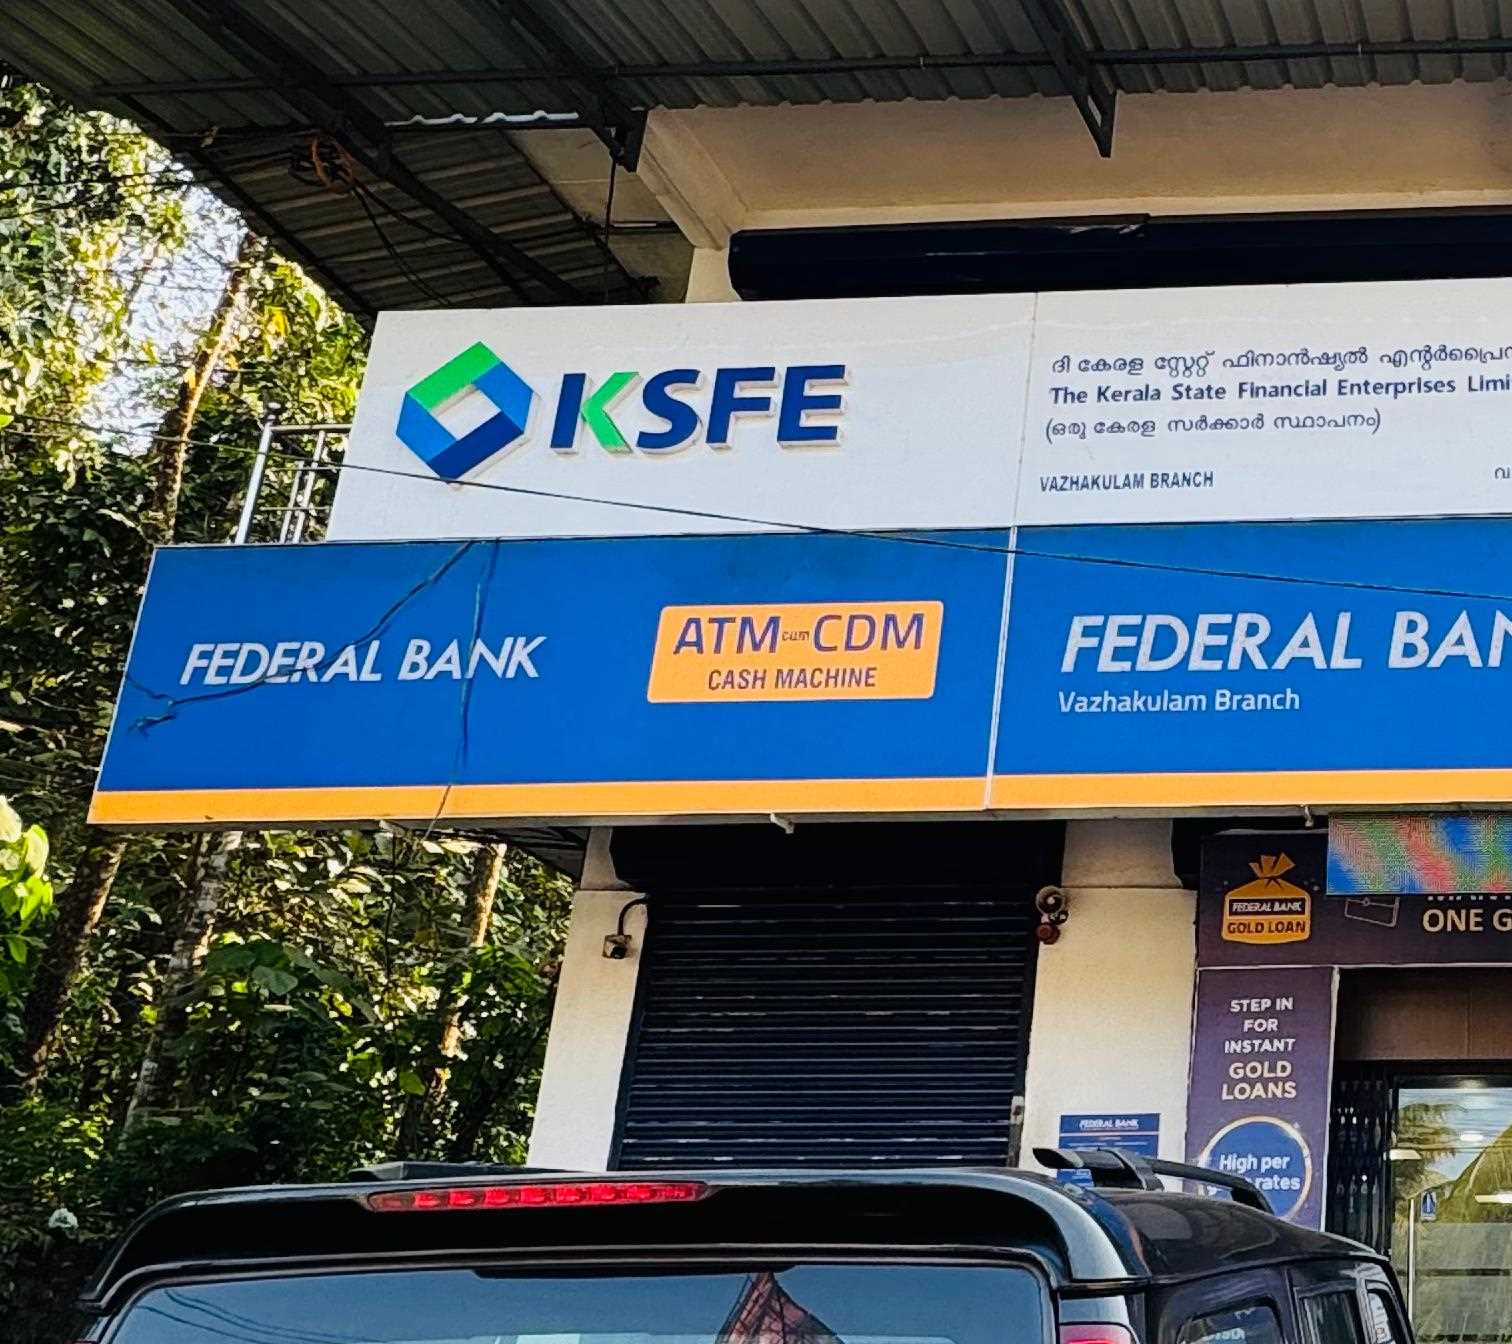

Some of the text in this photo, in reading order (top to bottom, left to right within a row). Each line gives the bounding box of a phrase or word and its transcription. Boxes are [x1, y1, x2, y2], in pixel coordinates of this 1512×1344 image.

[1052, 354, 1070, 373] ദി
[1078, 356, 1144, 375] കേരള
[1222, 346, 1368, 372] ഫിനാൻഷ്യൽ
[1050, 386, 1088, 404] The
[1097, 384, 1161, 403] Kerala
[1171, 382, 1227, 400] State
[1238, 379, 1327, 399] Financial
[1338, 376, 1456, 399] Enterprises
[549, 362, 848, 454] KSFE
[1046, 408, 1382, 444] (ഒരു കേരള സർക്കാർ സ്ഥാപനം)
[1040, 470, 1215, 492] VAZHAKULAM BRANCH
[673, 616, 781, 654] ATM
[814, 613, 924, 652] CDM
[1061, 612, 1363, 673] FEDERAL
[180, 636, 547, 686] FEDERAL BANK
[708, 667, 877, 690] CASH MACHINE
[1058, 688, 1300, 713] Vazhakulam Branch
[1232, 902, 1302, 912] FEDERAL BANK
[1227, 921, 1305, 934] GOLD LOAN
[1422, 909, 1484, 932] ONE
[1230, 997, 1294, 1013] STEP IN
[1243, 1019, 1278, 1032] FOR
[1224, 1039, 1296, 1054] INSTANT
[1229, 1060, 1292, 1079] GOLD
[1221, 1081, 1297, 1101] LOANS
[1219, 1154, 1291, 1175] High per
